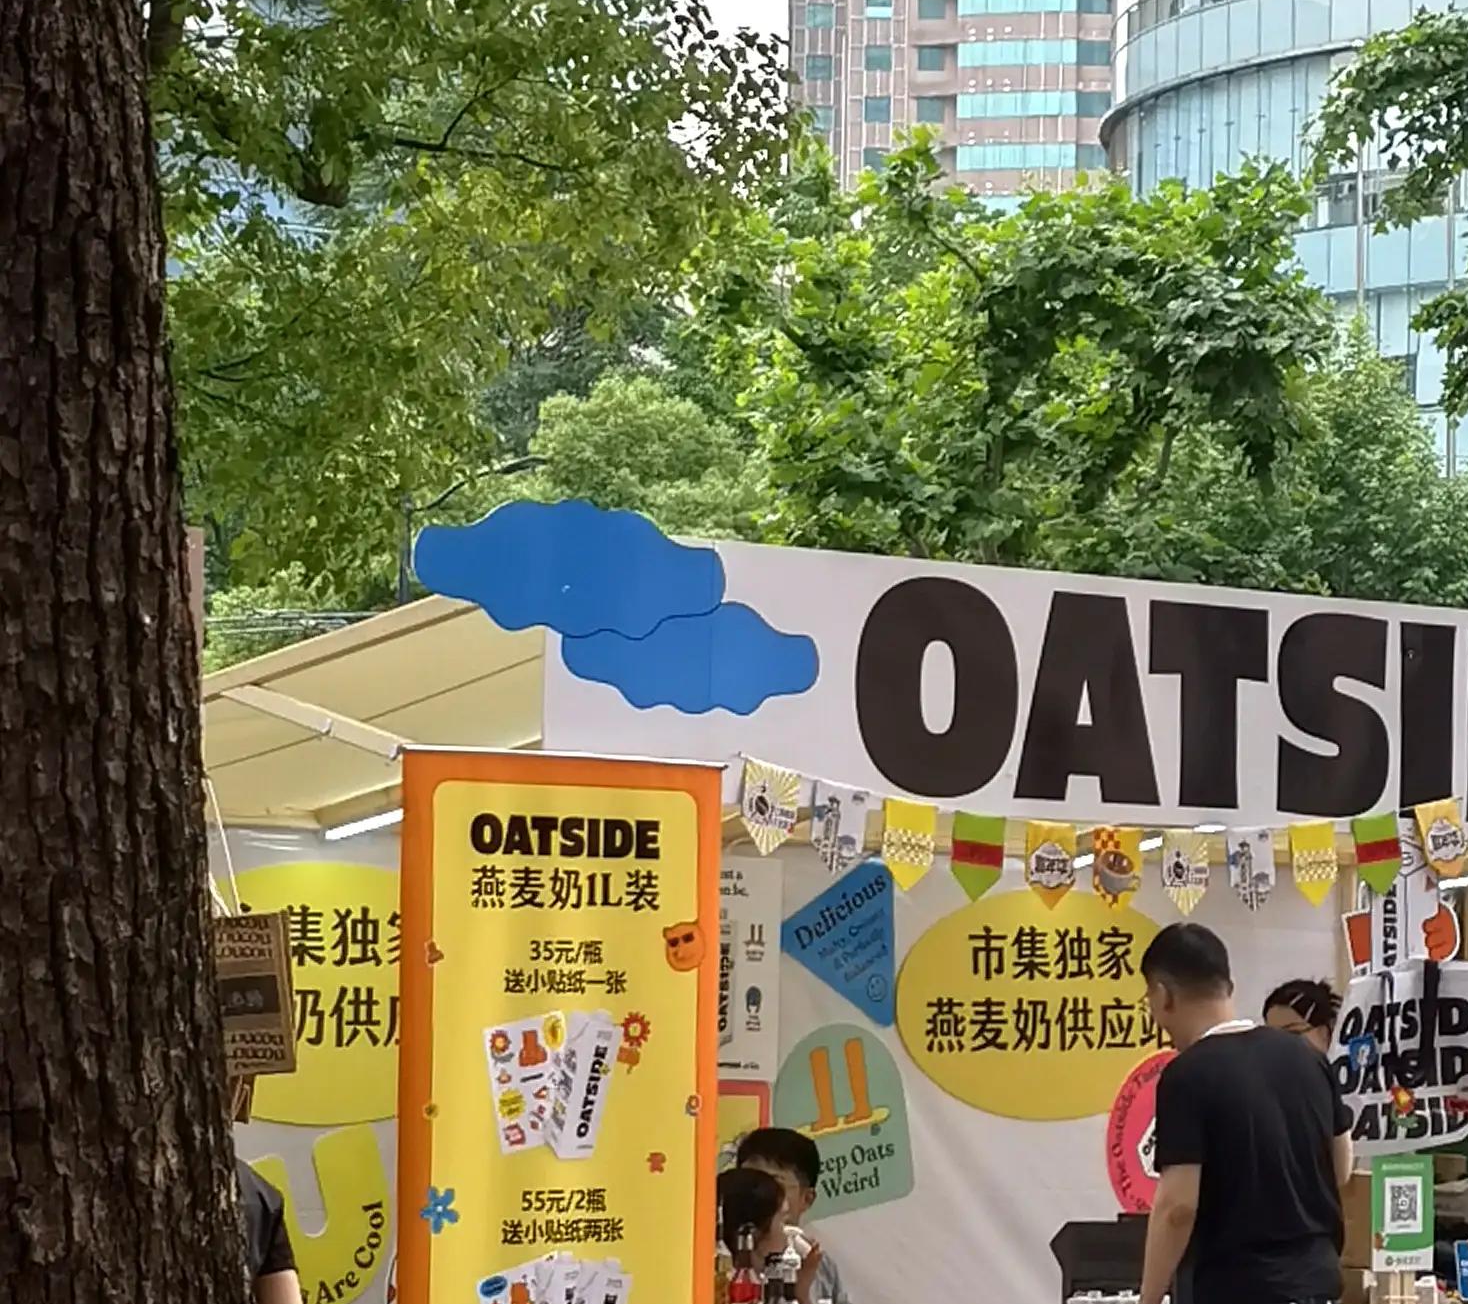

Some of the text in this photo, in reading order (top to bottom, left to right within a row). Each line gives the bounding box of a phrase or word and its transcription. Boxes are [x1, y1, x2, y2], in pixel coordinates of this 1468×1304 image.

[470, 813, 660, 860] OATSIDE
[471, 865, 660, 912] 燕麦奶1L装
[794, 874, 887, 950] Delicious
[1382, 884, 1398, 968] ATSIDE
[529, 940, 604, 964] 35元/瓶
[968, 926, 1135, 981] 市集独家
[504, 968, 627, 994] 送小贴纸一张
[576, 1045, 609, 1138] OATSIDE
[818, 1142, 895, 1176] eep Oats
[821, 1167, 880, 1198] Weird
[521, 1188, 607, 1213] 55元/2瓶
[354, 1200, 385, 1269] Cool
[502, 1218, 624, 1244] 送小贴纸两张
